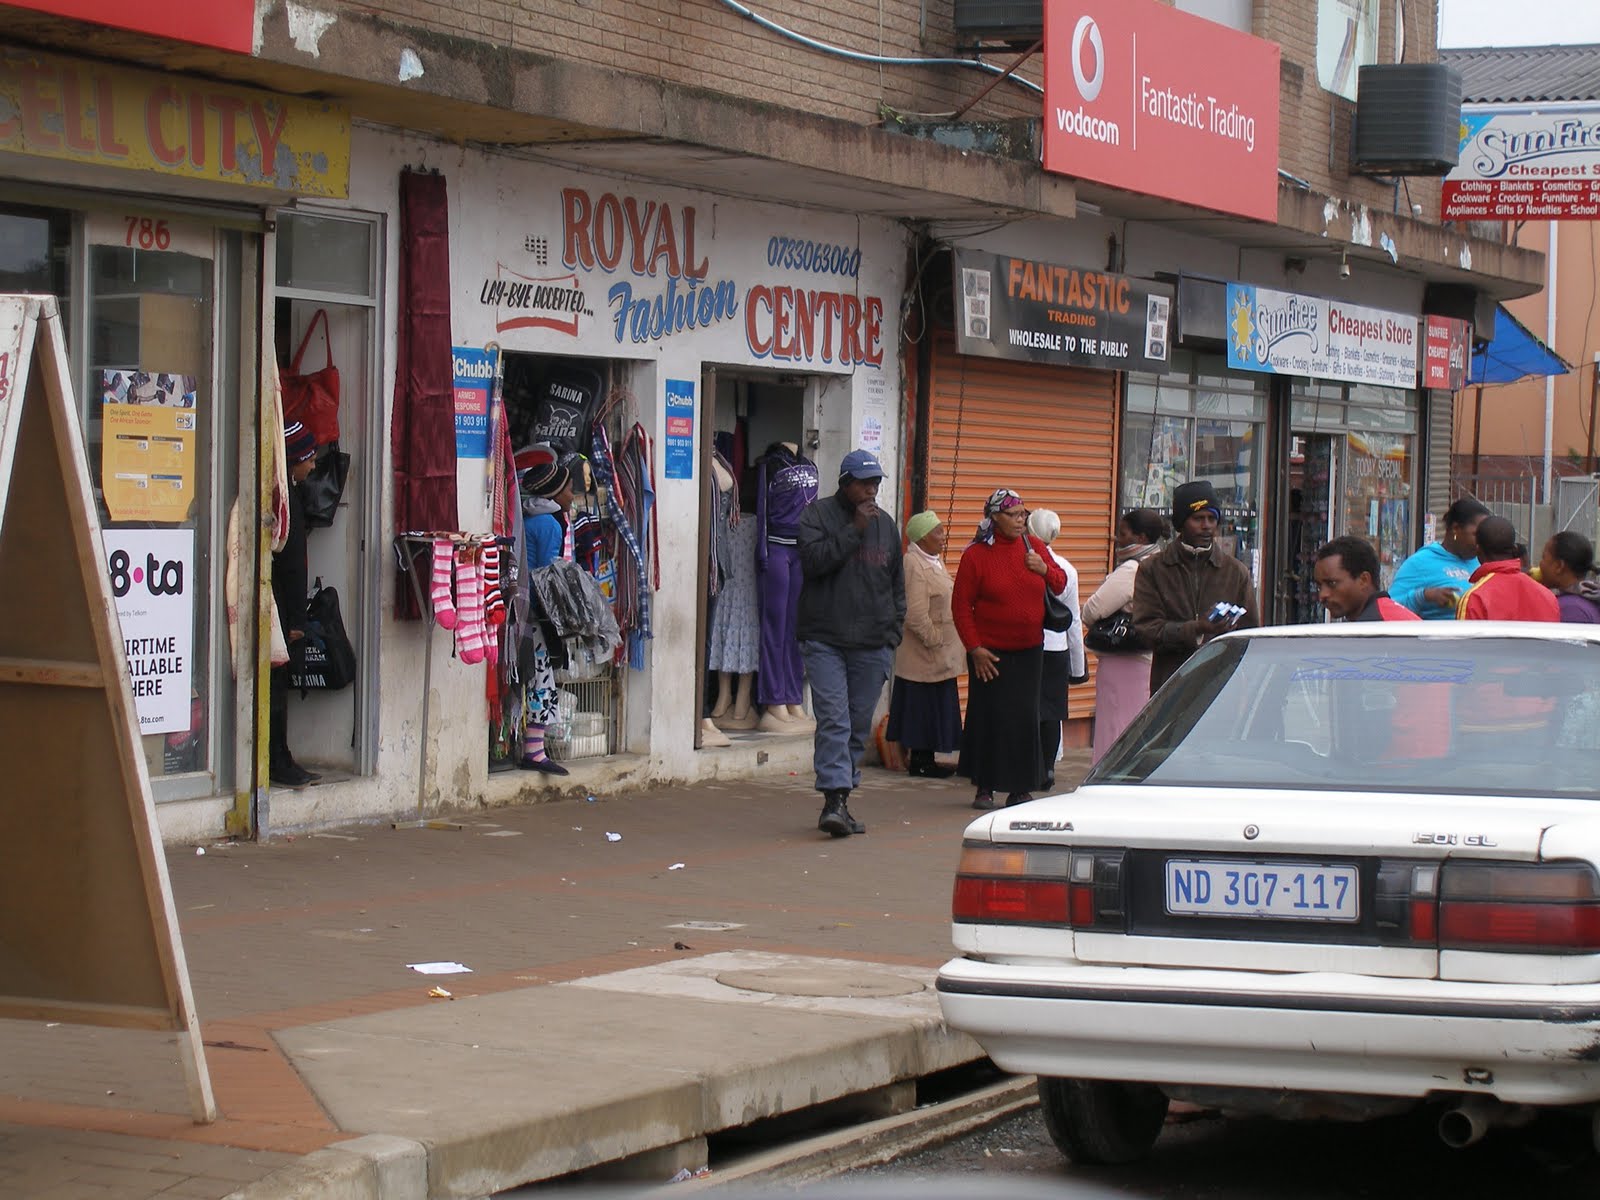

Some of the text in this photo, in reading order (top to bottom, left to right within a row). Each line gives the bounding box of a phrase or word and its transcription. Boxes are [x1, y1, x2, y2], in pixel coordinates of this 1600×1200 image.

[0, 60, 287, 178] ELL CITY
[1142, 75, 1255, 153] Fantastic Trading
[1056, 106, 1119, 146] vodacom
[1508, 164, 1586, 178] Cheapest
[1460, 181, 1492, 193] Clothing
[1500, 181, 1534, 191] Blankets
[1542, 181, 1583, 191] Cosmetics
[1452, 193, 1490, 203] Cookware
[1498, 193, 1533, 205] Crockery
[1541, 193, 1578, 203] Furniture
[1446, 205, 1488, 216] Appliances
[1495, 204, 1514, 215] Gifts
[1526, 204, 1562, 215] Novelties
[1570, 205, 1598, 215] School
[124, 215, 171, 250] 786
[560, 187, 710, 282] ROYAL
[767, 236, 862, 278] 0733063060
[480, 279, 533, 308] LAY-BYE
[1008, 258, 1131, 315] FANTASTIC
[607, 277, 739, 345] Fashion
[1048, 309, 1096, 327] TRADING
[745, 284, 884, 369] CENTRE
[1256, 295, 1318, 365] SunFree
[1329, 308, 1413, 347] Cheapest Store
[1428, 325, 1448, 340] SUNFREE
[1009, 329, 1129, 358] WHOLESALE TO THE PUBLIC
[1428, 345, 1448, 359] CHEAPEST
[455, 357, 493, 379] Chubb
[1431, 366, 1444, 378] STORE
[457, 391, 476, 400] ARMED
[550, 383, 582, 404] SARINA
[674, 395, 693, 406] Chubb
[463, 416, 475, 426] 903
[475, 416, 487, 427] 911
[535, 423, 577, 439] Sarina
[1355, 457, 1377, 478] TODAY
[125, 637, 176, 656] IRTIME
[127, 657, 182, 677] AILABLE
[1009, 821, 1074, 832] COROLLA
[1464, 834, 1498, 847] GL
[1174, 869, 1349, 909] ND 307-117
